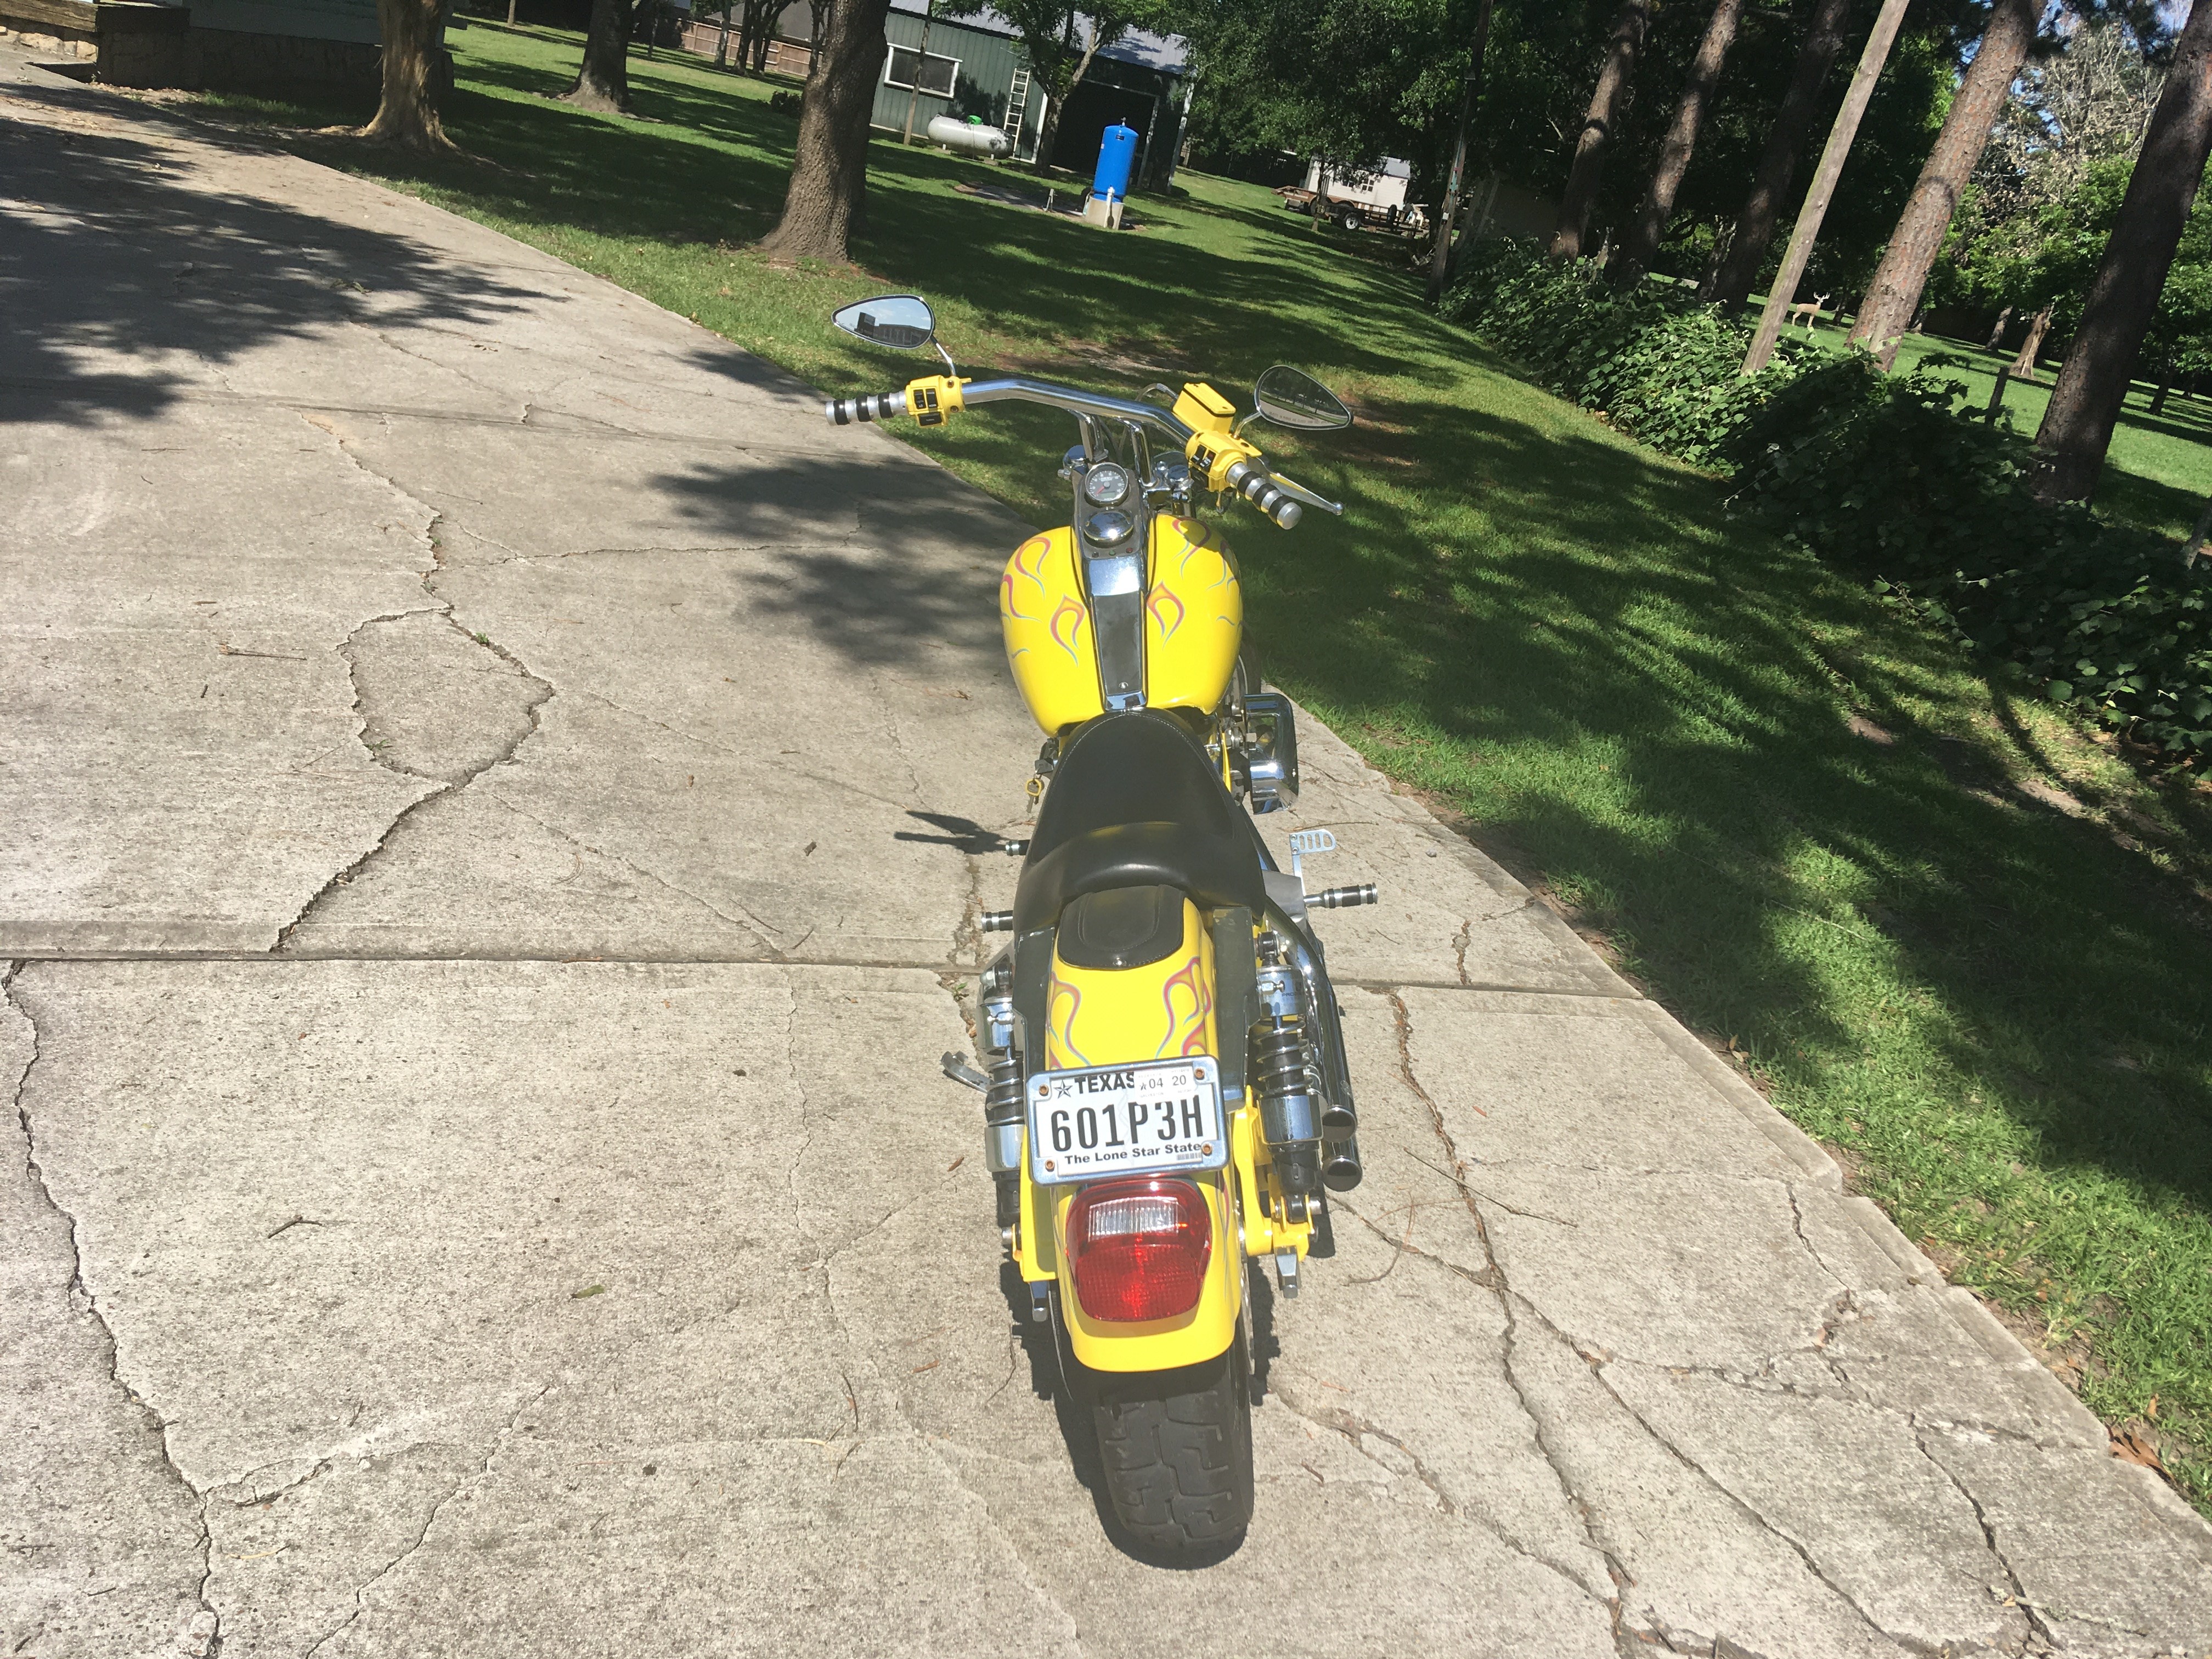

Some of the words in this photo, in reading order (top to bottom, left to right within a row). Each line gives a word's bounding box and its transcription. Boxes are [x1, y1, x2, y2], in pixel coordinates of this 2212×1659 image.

[1074, 1071, 1135, 1094] TEXAS
[1148, 1077, 1164, 1089] 04
[1172, 1074, 1187, 1086] 20
[1051, 1095, 1204, 1152] 601P3H
[1064, 1155, 1090, 1165] The
[1095, 1149, 1127, 1161] Lone
[1132, 1147, 1161, 1158] Star
[1165, 1143, 1201, 1154] State
